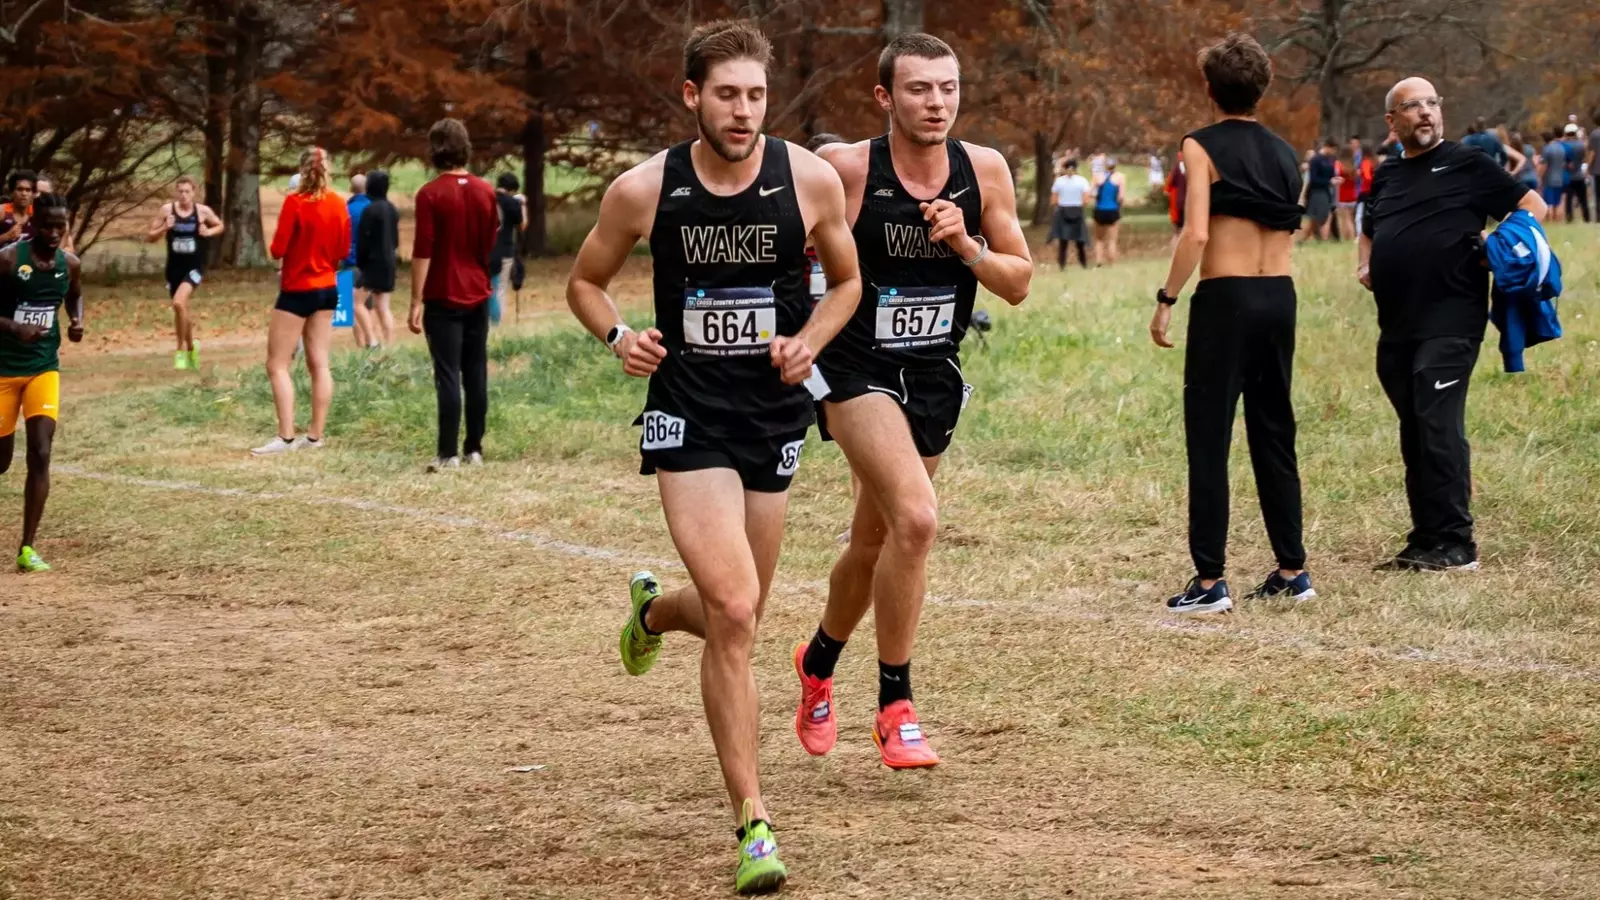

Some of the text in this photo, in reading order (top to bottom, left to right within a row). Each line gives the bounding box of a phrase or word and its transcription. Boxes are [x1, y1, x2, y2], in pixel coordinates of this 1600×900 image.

[670, 187, 692, 197] ACC
[873, 188, 894, 197] ACC
[681, 225, 777, 263] WAKE
[884, 222, 957, 259] WAK
[735, 297, 774, 305] CHAMPIONSHIPS
[23, 312, 48, 326] 550
[703, 311, 758, 344] 664
[892, 306, 940, 337] 657
[645, 415, 681, 443] 664
